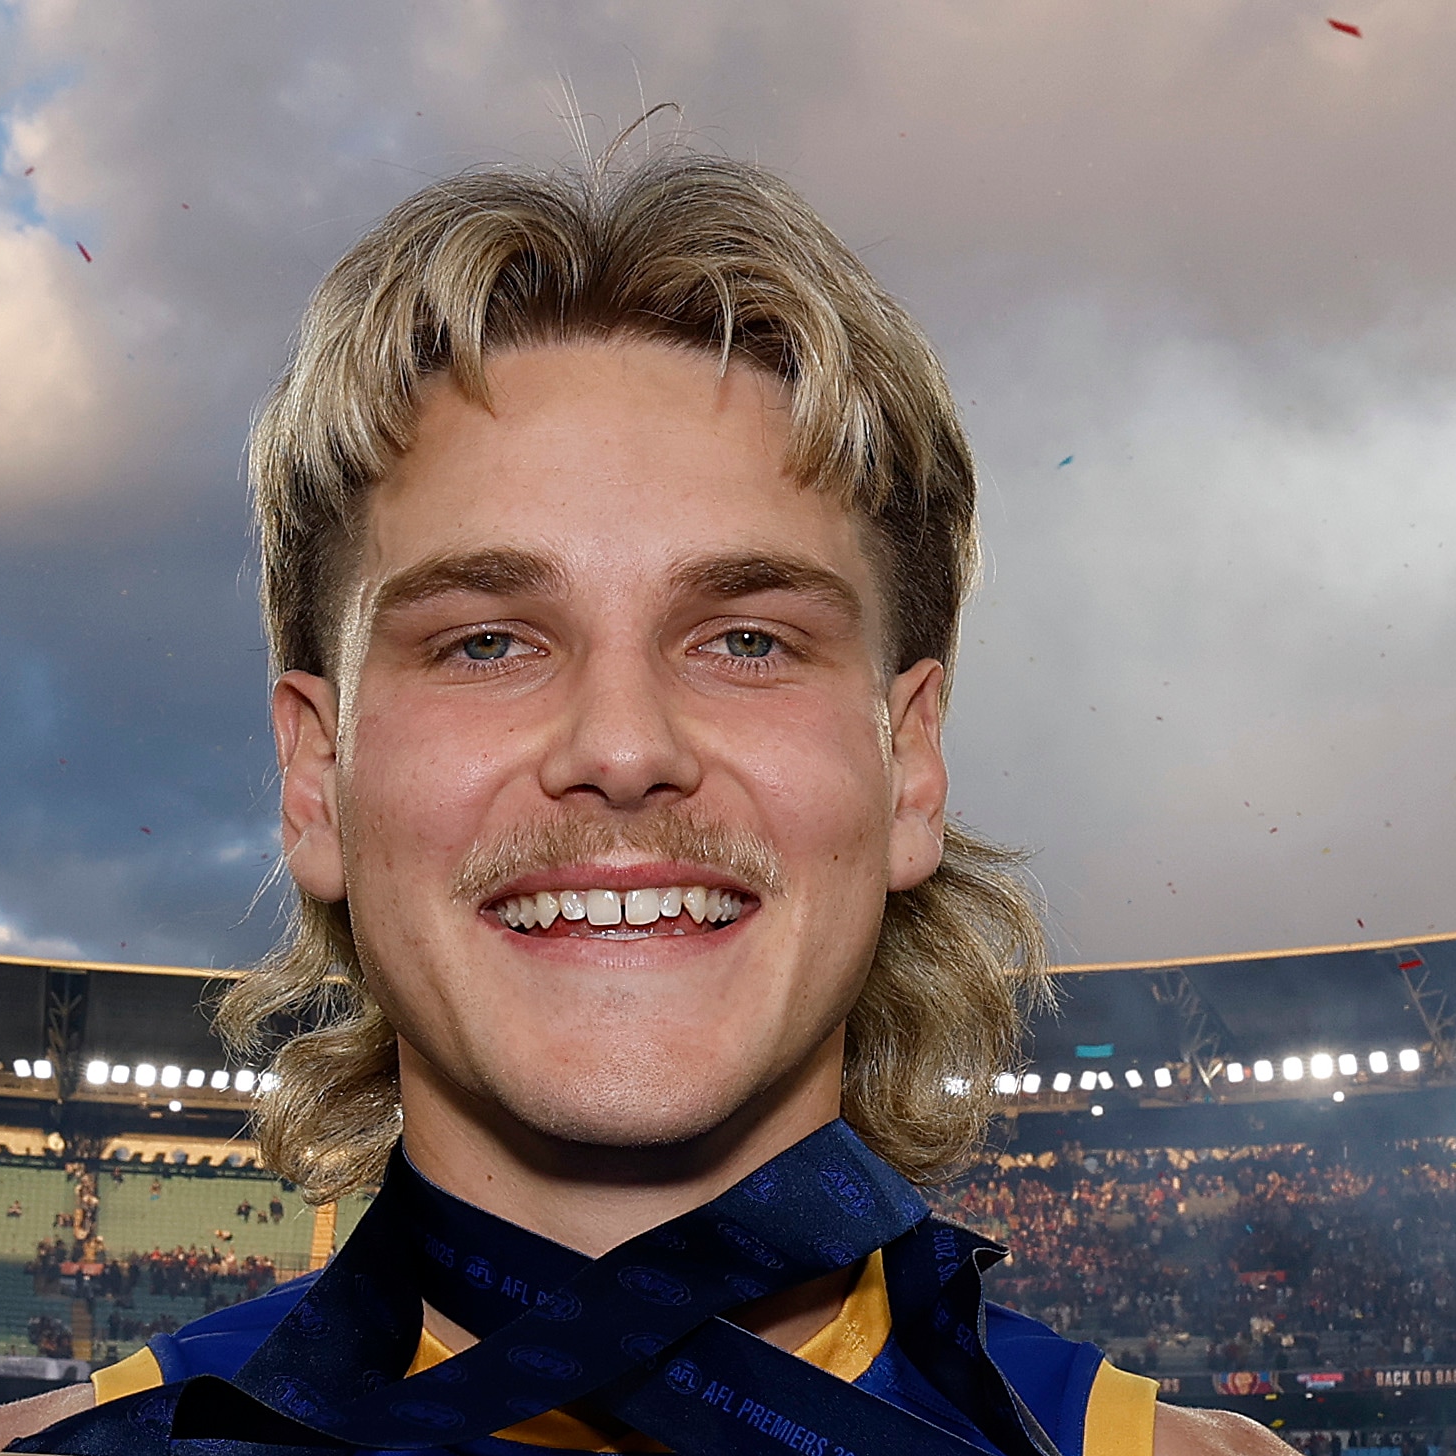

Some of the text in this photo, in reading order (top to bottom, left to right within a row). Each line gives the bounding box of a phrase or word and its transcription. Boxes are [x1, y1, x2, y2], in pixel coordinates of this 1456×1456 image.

[500, 1274, 531, 1306] AFL
[1375, 1370, 1412, 1388] BACK
[701, 1379, 736, 1414] AFL
